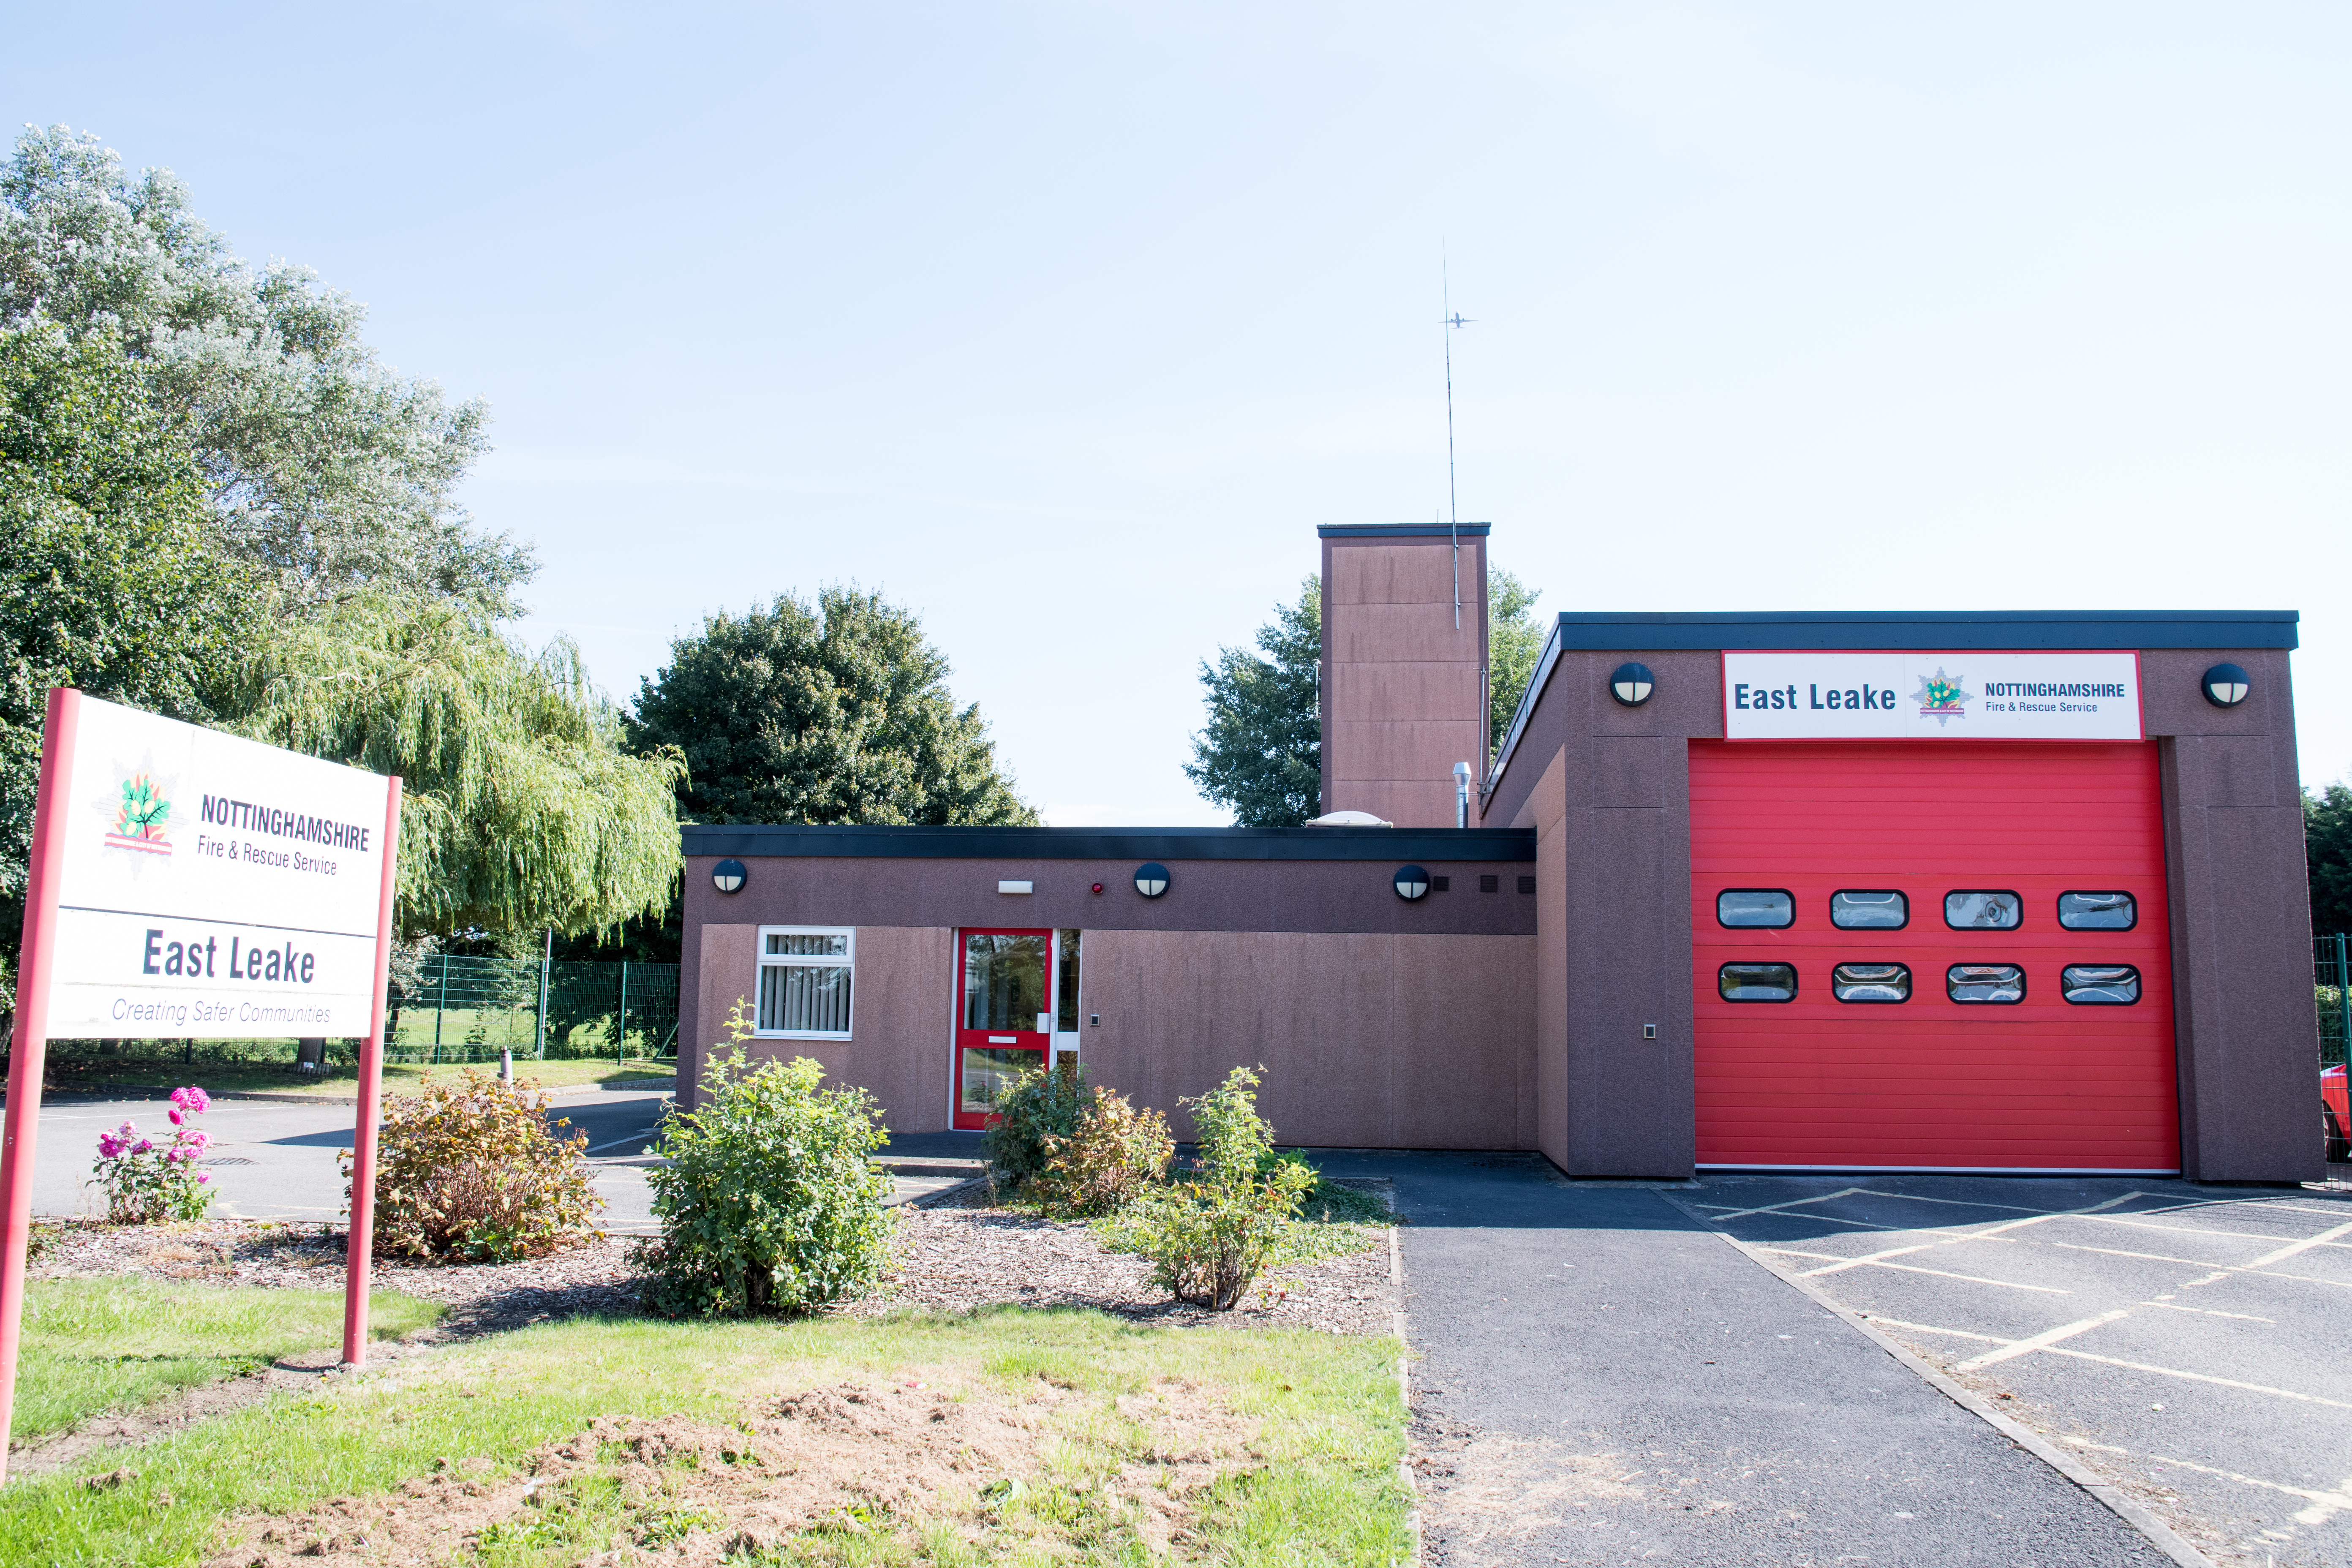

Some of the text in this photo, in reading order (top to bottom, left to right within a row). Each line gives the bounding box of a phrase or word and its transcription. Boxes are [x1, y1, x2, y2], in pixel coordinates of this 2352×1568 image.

[1735, 684, 1895, 710] East Leake
[1986, 683, 2125, 697] NOTTINGHAMSHIRE
[1986, 702, 2097, 712] Fire & Rescue Service
[201, 794, 369, 852] NOTTINGHAMSHIRE
[198, 835, 336, 875] Fire & Rescue Service
[143, 929, 315, 983] East Leake
[113, 999, 330, 1026] Creating Safer Communities
